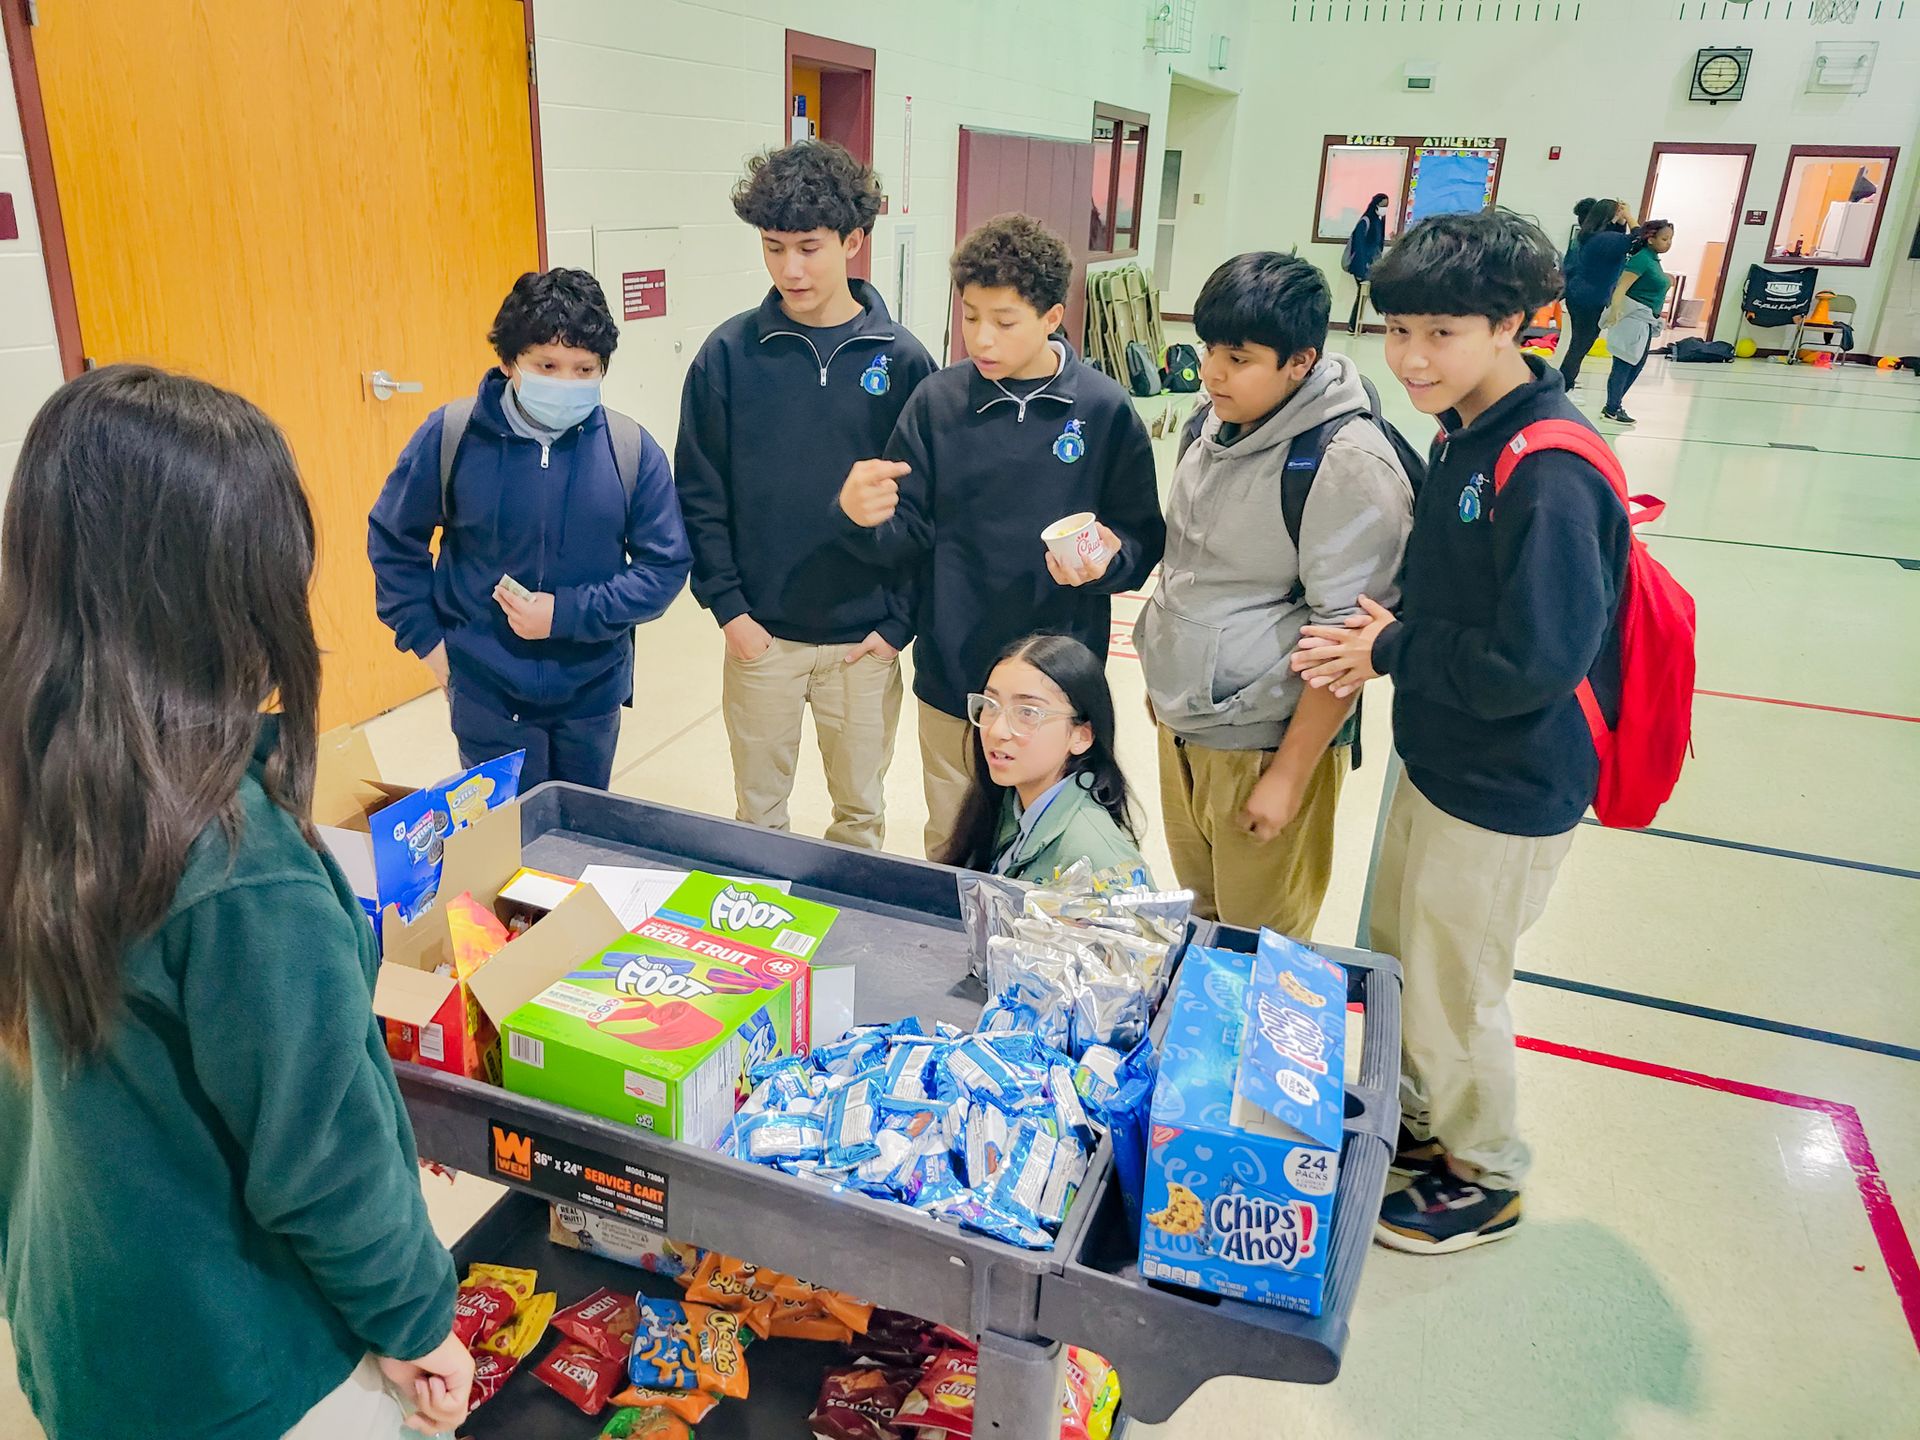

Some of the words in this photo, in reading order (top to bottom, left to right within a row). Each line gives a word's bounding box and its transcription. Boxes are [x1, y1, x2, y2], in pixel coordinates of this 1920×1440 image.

[1346, 135, 1396, 146] EAGLES
[1423, 136, 1497, 148] ATHLETICS
[710, 891, 797, 932] FOOT
[638, 922, 692, 948] REAL
[690, 940, 758, 966] FRUIT
[767, 960, 795, 974] 48
[615, 960, 714, 1000] FOOT
[1285, 1008, 1321, 1061] Chips
[498, 1158, 528, 1176] WEN
[625, 1164, 646, 1179] MODEL
[1297, 1153, 1328, 1172] 24
[534, 1151, 553, 1167] 36"
[563, 1161, 583, 1177] 24"
[584, 1167, 632, 1193] SERVICE
[633, 1183, 665, 1204] CART
[1295, 1169, 1328, 1181] PACKS
[560, 1206, 579, 1216] REAL
[1214, 1196, 1296, 1234] Chips
[706, 1311, 739, 1376] Cheetos
[826, 1398, 896, 1420] Doritos
